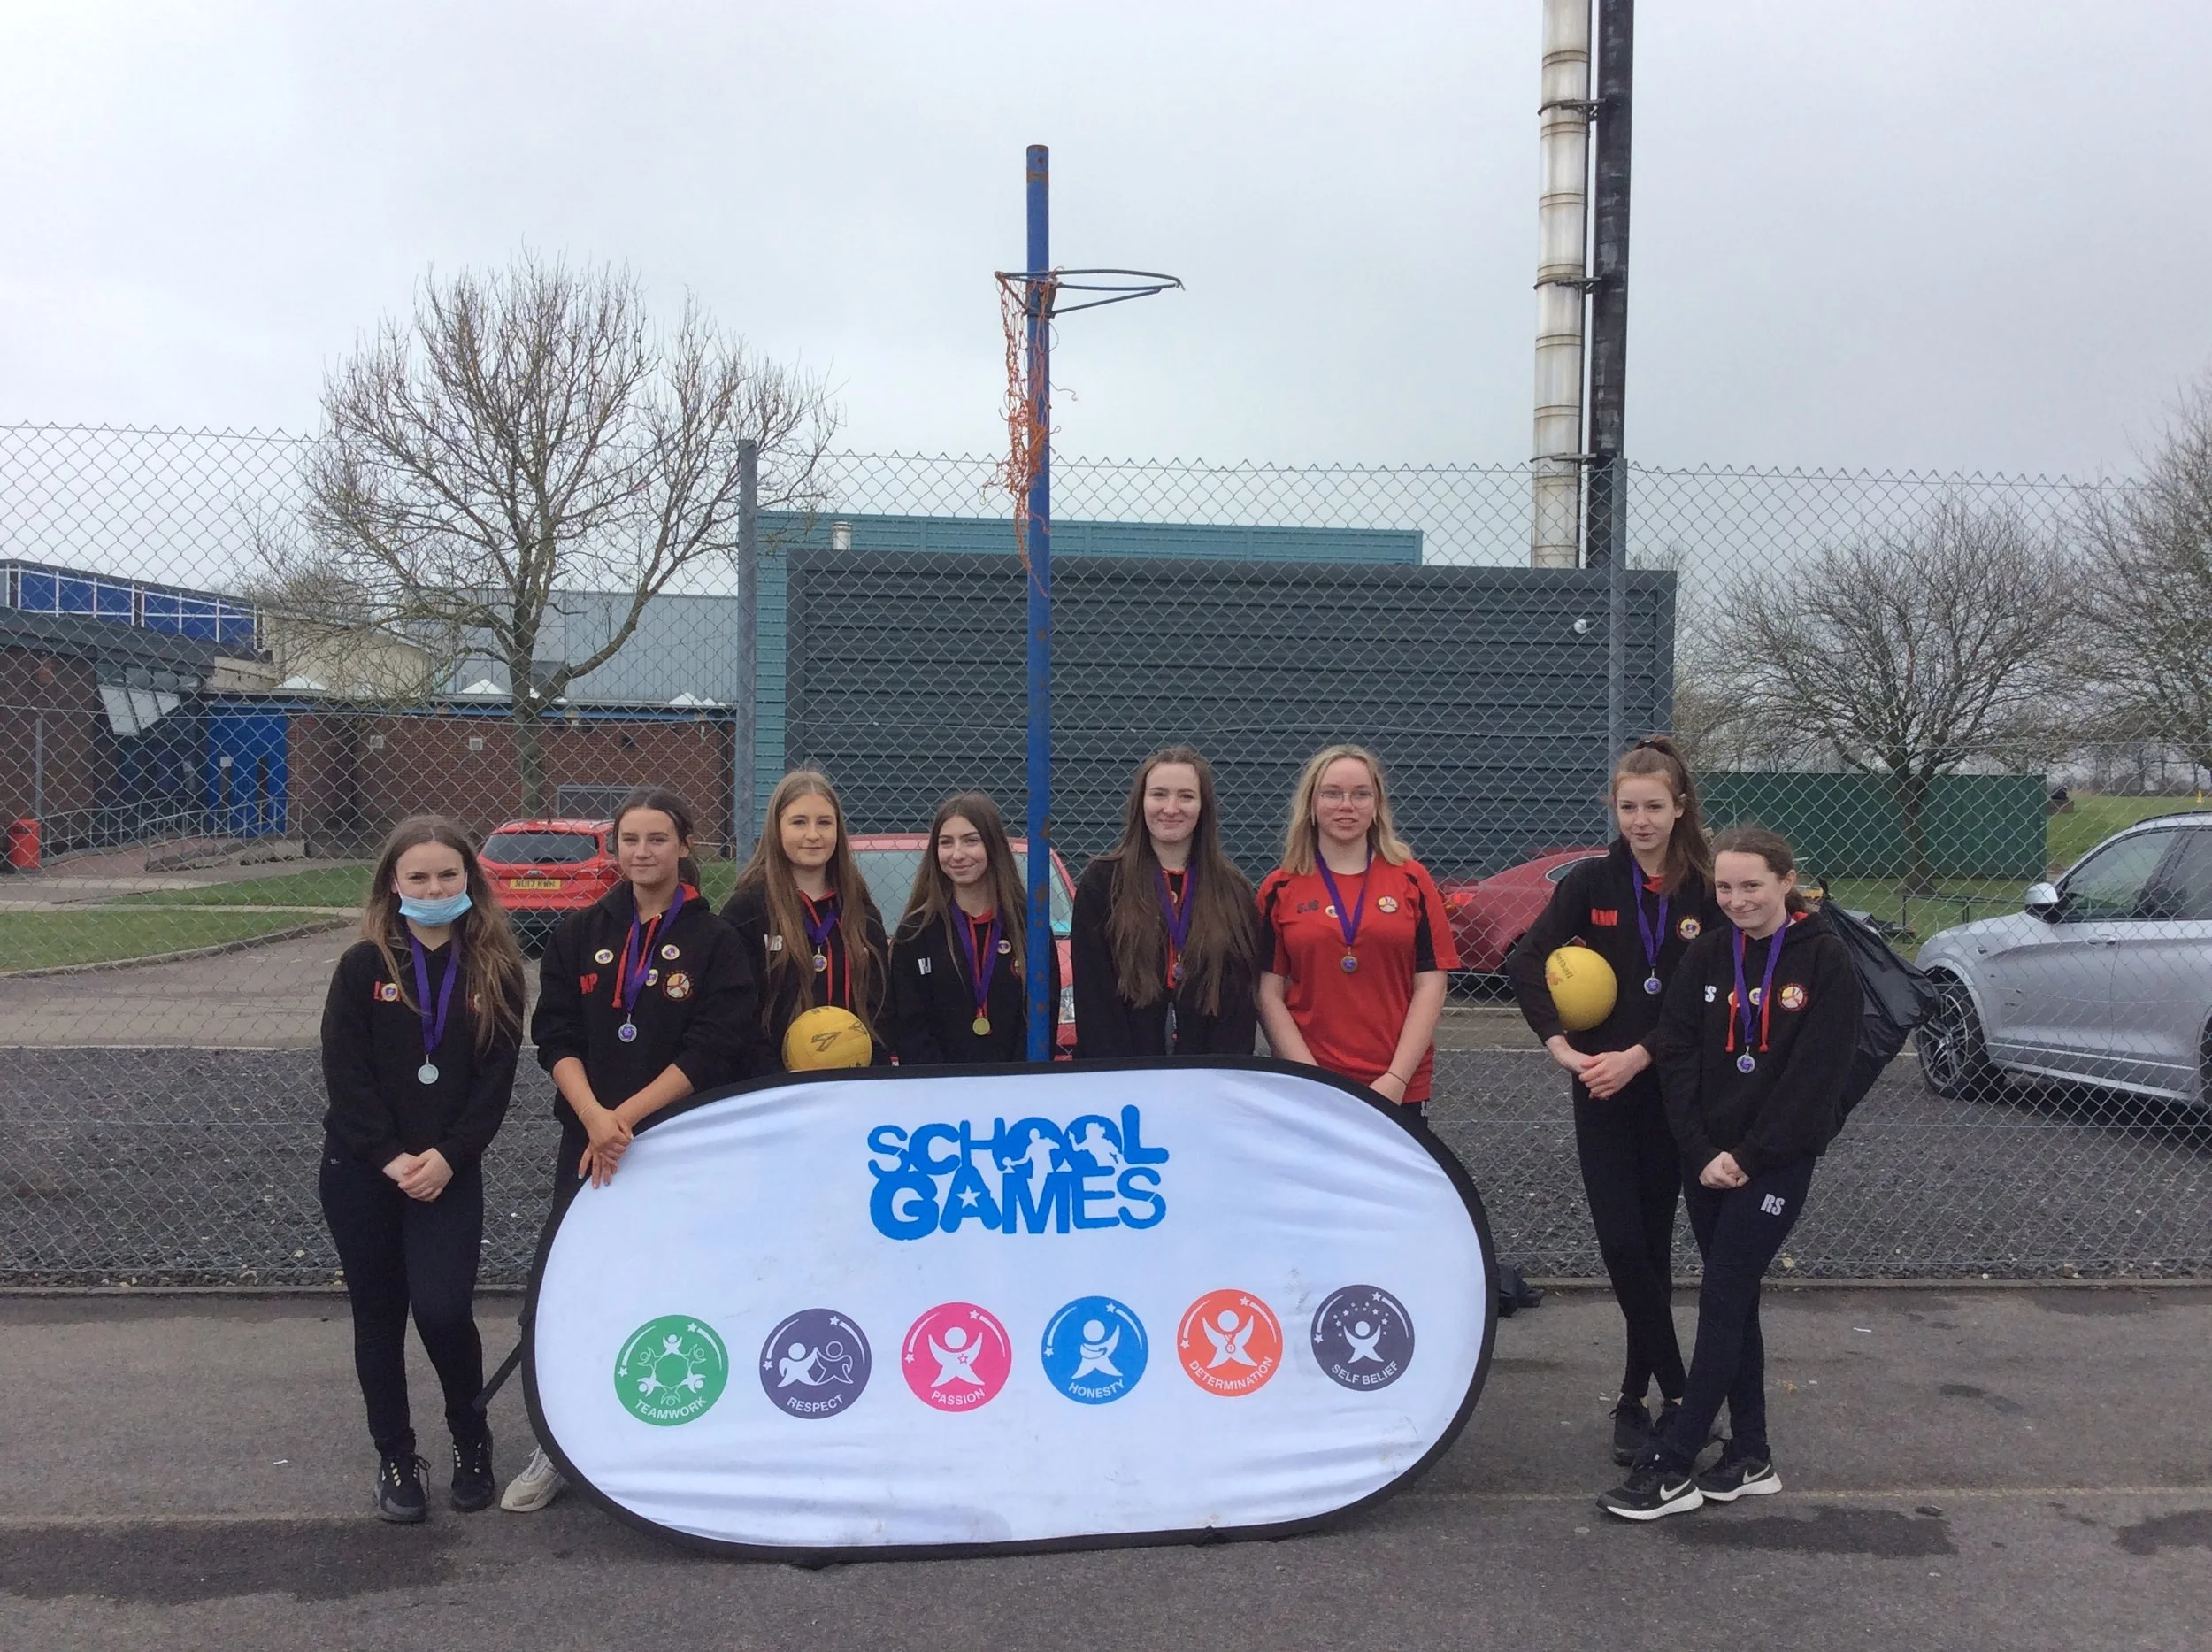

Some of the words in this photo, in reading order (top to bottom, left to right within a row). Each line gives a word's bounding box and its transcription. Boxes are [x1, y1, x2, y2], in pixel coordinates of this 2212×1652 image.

[1704, 985, 1717, 1003] S
[867, 1104, 1170, 1175] SCHOOL
[870, 1165, 1167, 1241] GAMES
[1760, 1193, 1786, 1216] RS
[1188, 1356, 1273, 1390] DETERMINATION
[1331, 1364, 1359, 1385] SELF
[1362, 1361, 1399, 1385] BELIEF
[931, 1387, 986, 1406] PASSION
[1068, 1380, 1125, 1399] HONESTY
[634, 1398, 708, 1419] TEAMWORK
[787, 1394, 844, 1413] RESPECT
